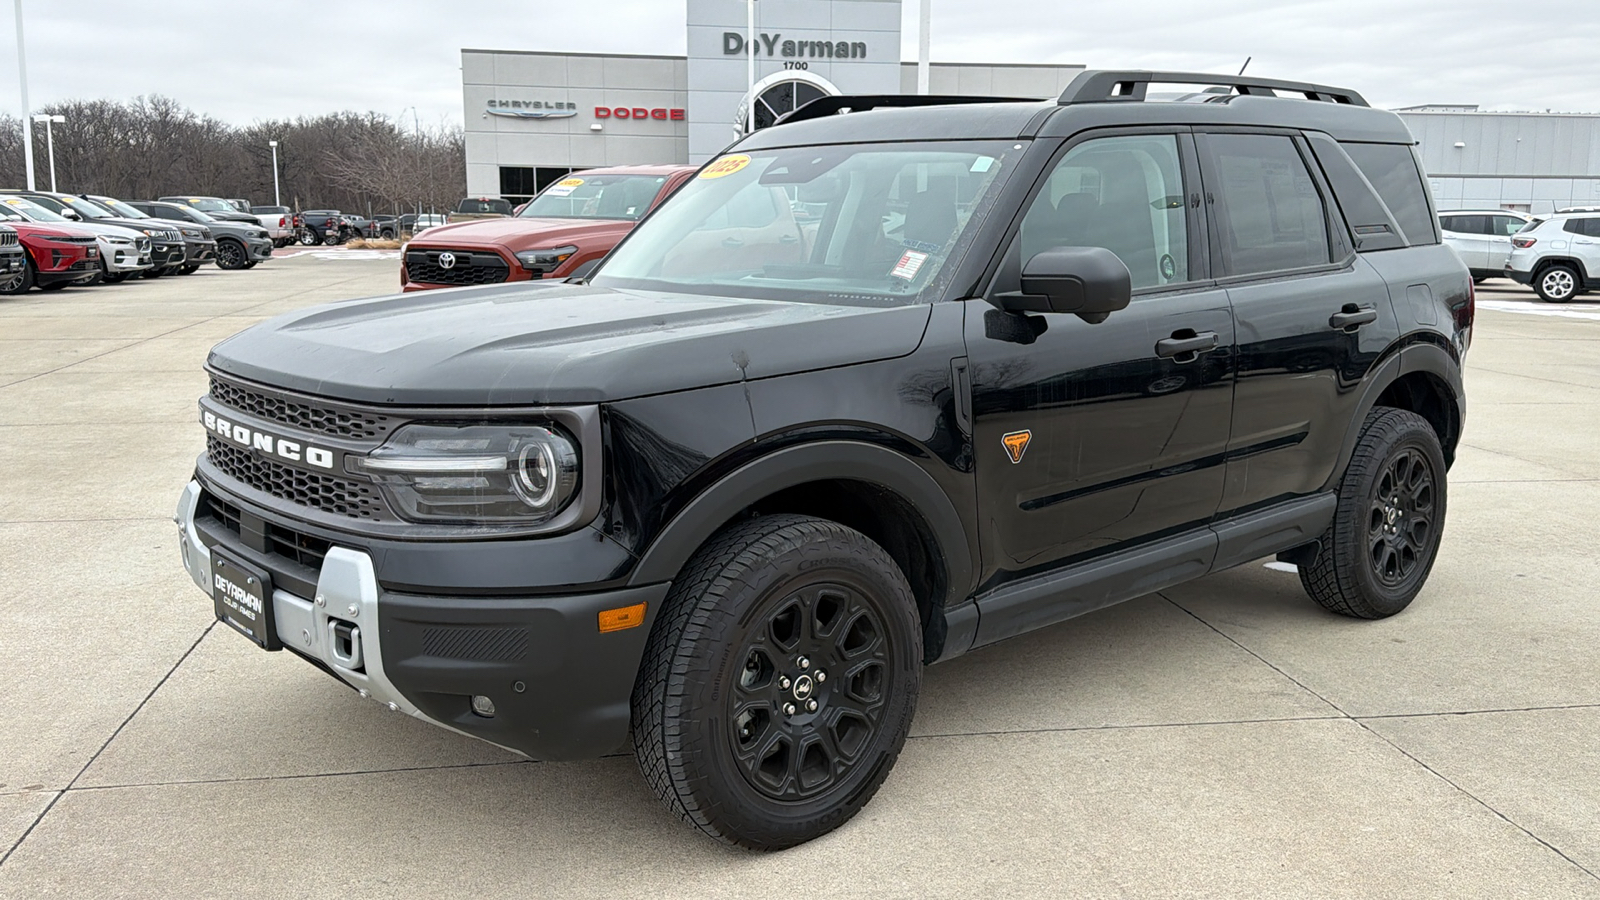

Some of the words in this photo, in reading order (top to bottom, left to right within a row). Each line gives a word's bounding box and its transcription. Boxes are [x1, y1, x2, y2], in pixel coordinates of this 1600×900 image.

[722, 32, 867, 59] DeYarman
[783, 61, 808, 70] 1700
[487, 99, 577, 110] CHRYSLER
[594, 106, 686, 121] DODGE
[702, 159, 748, 174] 2025
[204, 411, 334, 469] BRONCO
[215, 573, 262, 614] DEYARMAN
